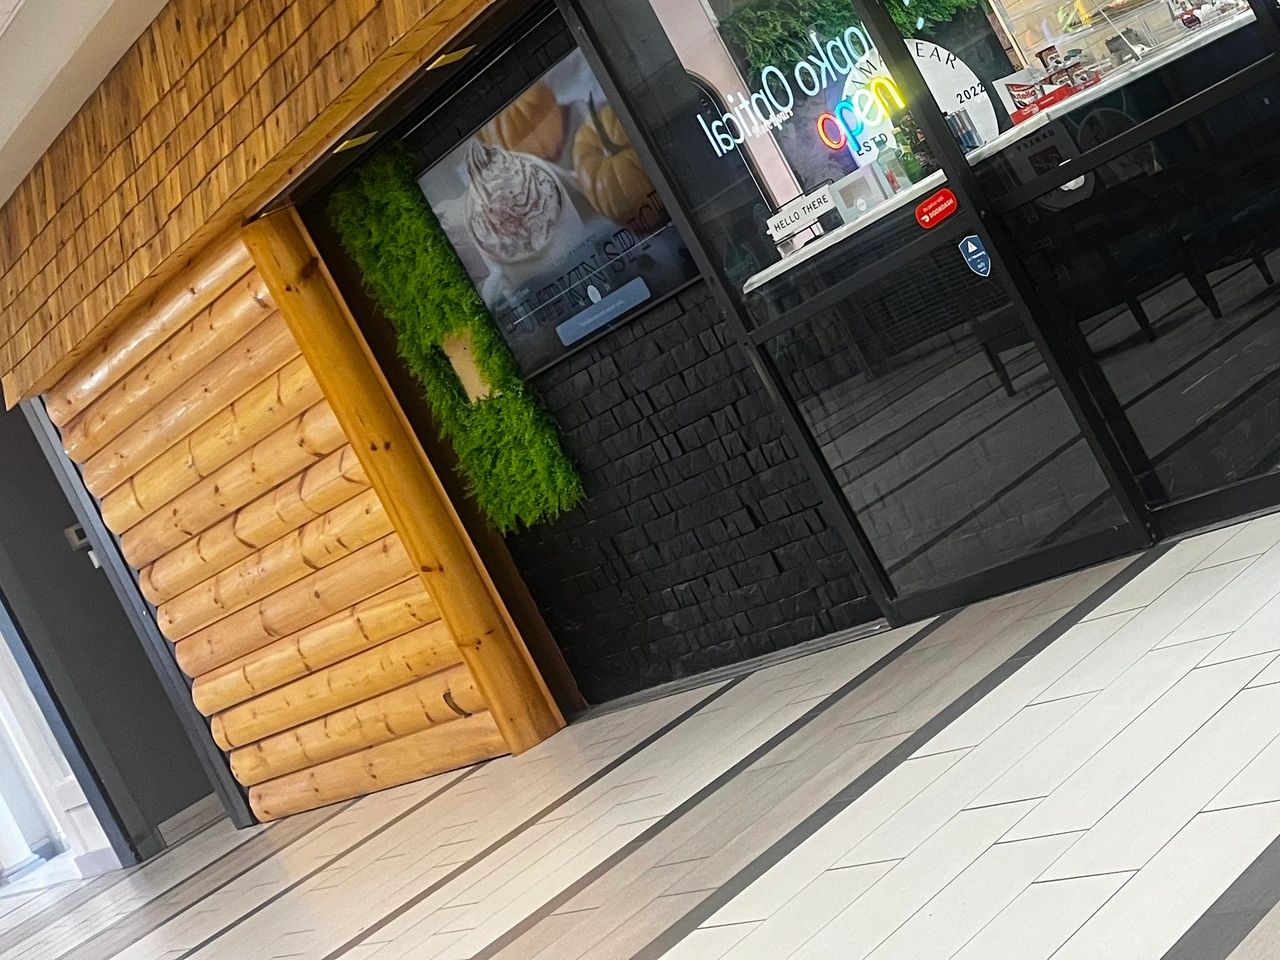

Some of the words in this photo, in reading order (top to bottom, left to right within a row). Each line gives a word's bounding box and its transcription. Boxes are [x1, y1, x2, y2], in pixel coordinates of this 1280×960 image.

[915, 42, 958, 69] EAR
[956, 82, 985, 104] 2022
[817, 75, 906, 151] open
[773, 211, 800, 232] HELLO
[801, 194, 829, 215] THERE
[928, 198, 954, 218] DOORDASH
